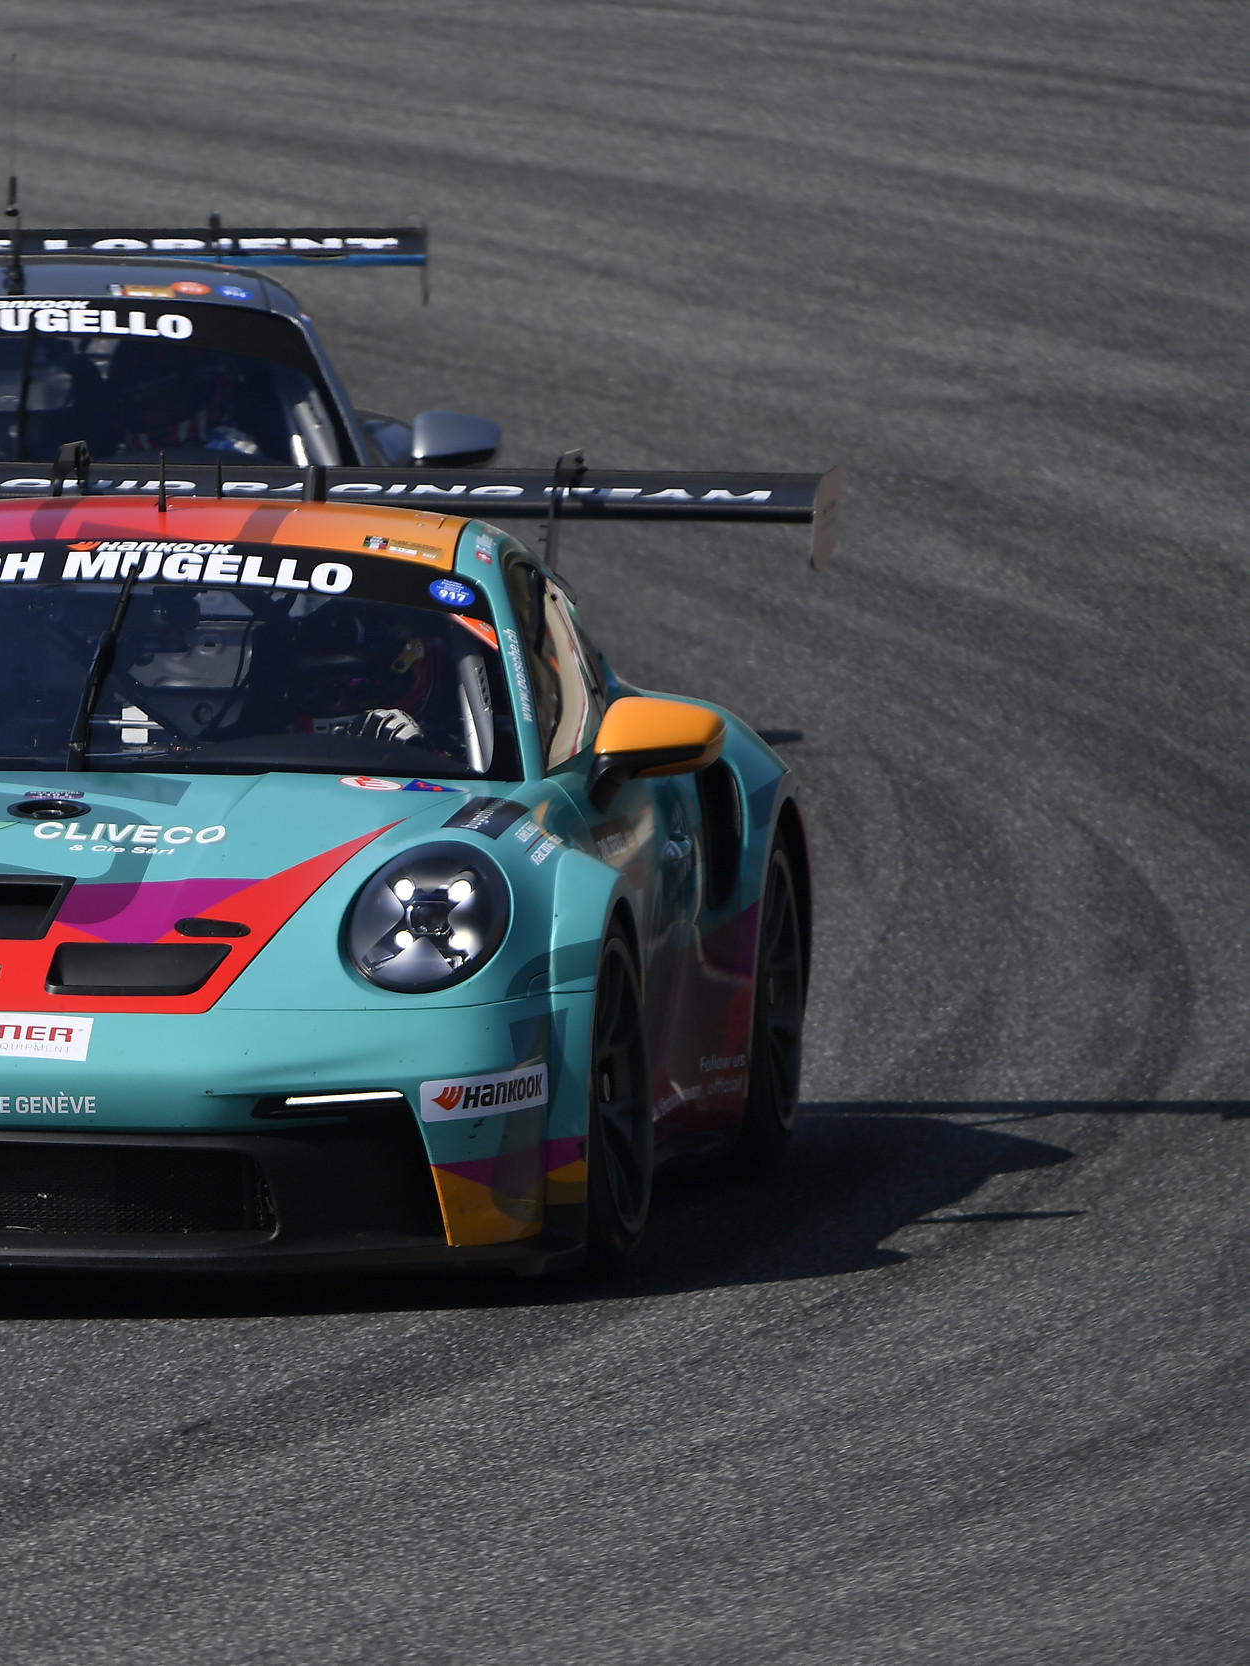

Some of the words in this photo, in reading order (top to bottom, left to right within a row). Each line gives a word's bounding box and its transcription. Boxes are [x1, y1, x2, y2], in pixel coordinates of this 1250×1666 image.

[61, 550, 354, 595] MUGELLO
[33, 821, 227, 846] CLIVECO
[15, 1091, 97, 1114] GENÈVE
